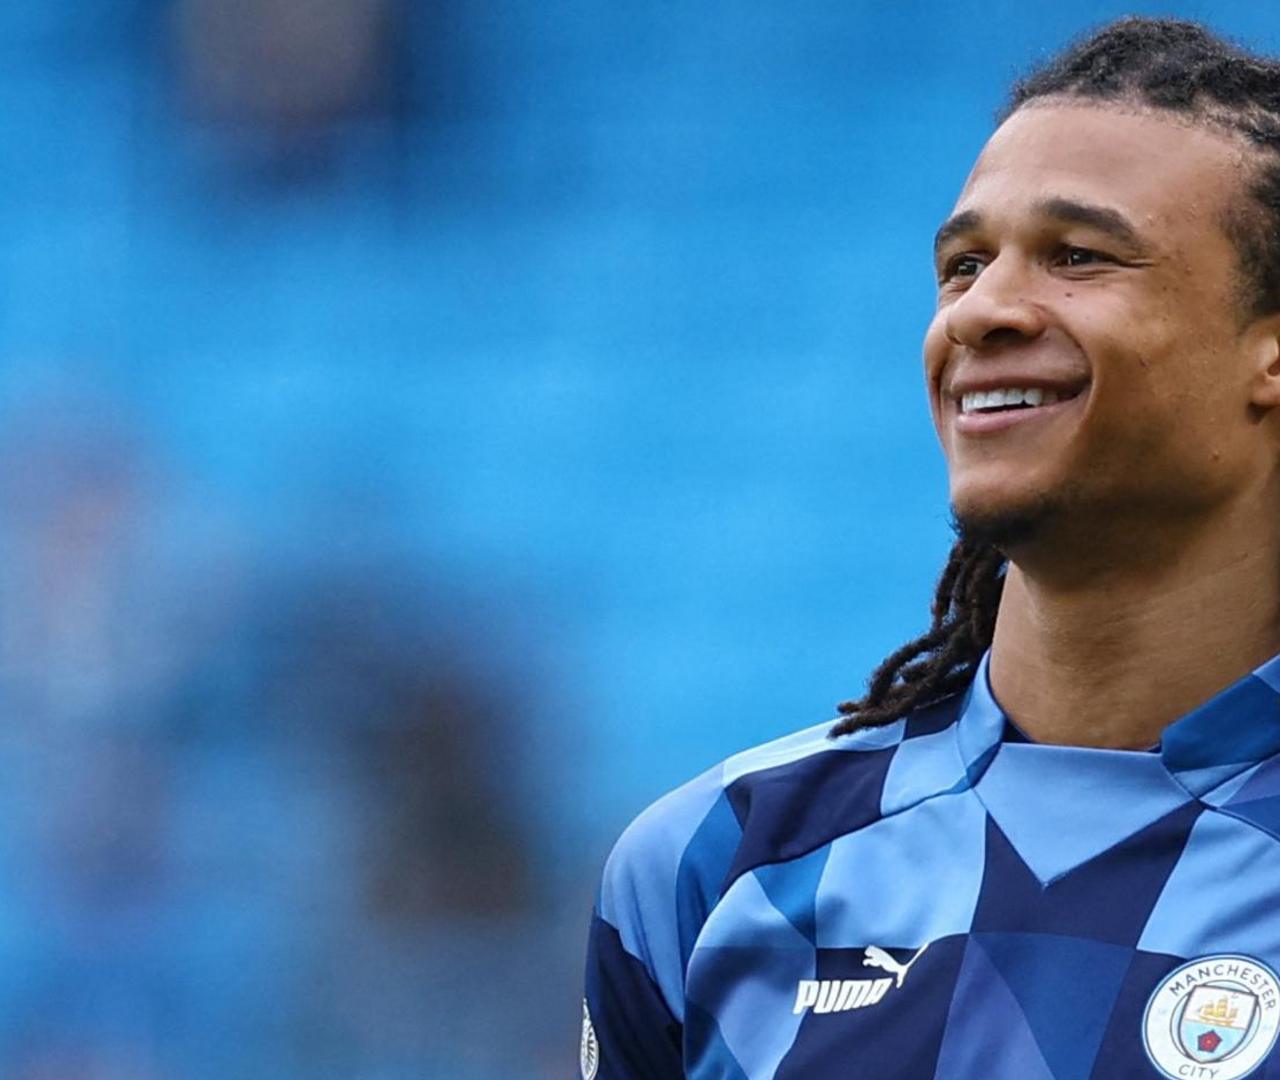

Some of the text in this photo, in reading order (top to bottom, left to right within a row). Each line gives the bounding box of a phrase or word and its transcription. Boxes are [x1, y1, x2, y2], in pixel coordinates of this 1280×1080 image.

[793, 978, 893, 1014] PUMA
[1169, 964, 1276, 1010] MANCHESTER
[1178, 1064, 1219, 1080] CITY
